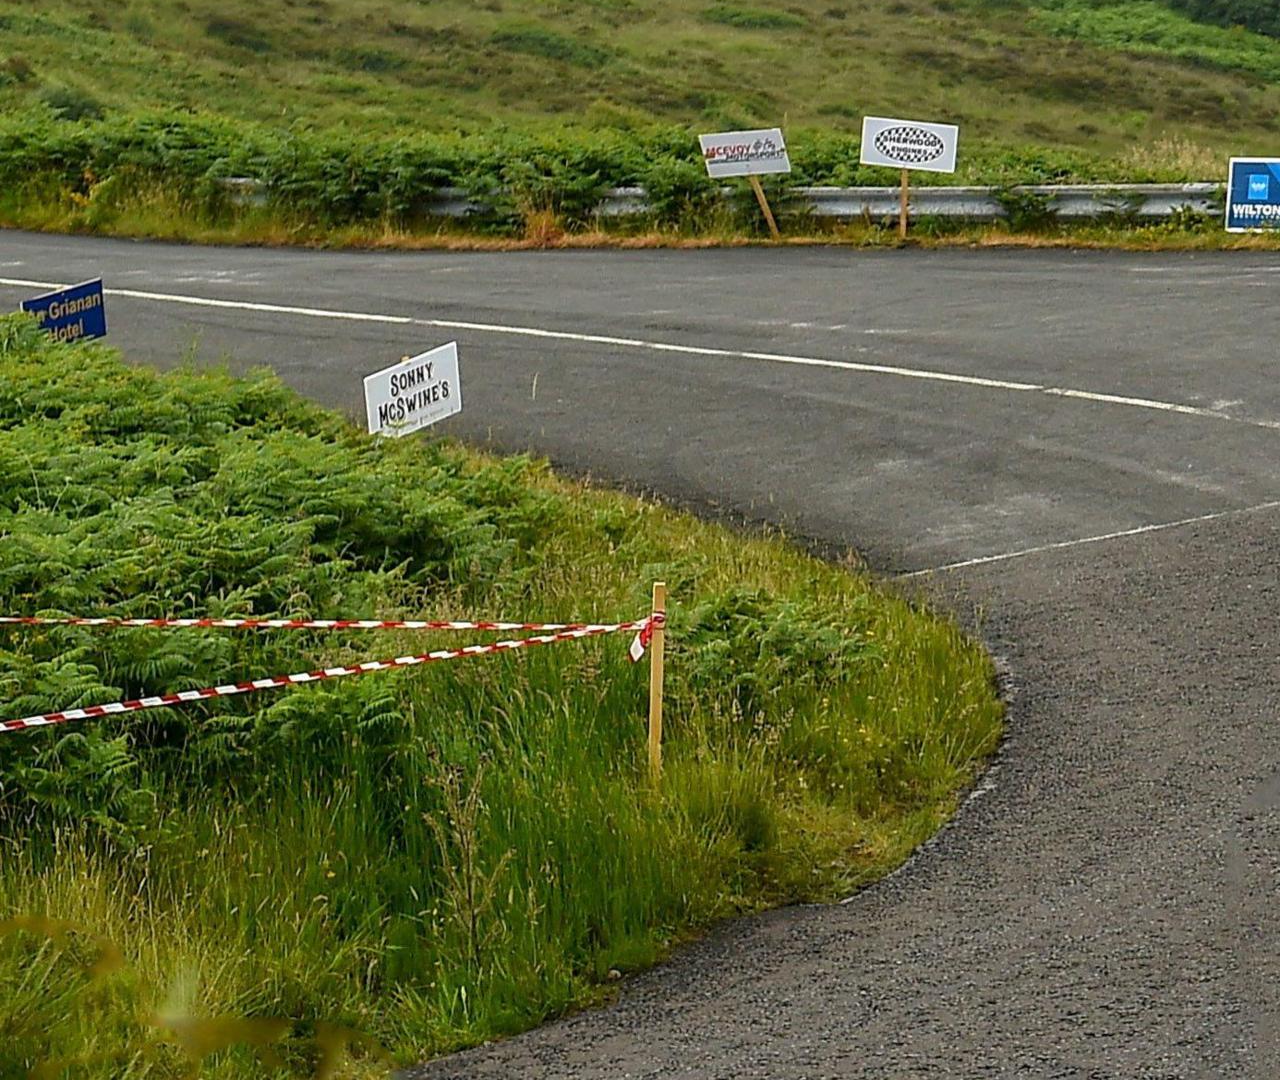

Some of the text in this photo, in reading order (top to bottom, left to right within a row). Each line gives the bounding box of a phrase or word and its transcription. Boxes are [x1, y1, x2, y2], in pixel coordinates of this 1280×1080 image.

[883, 135, 937, 147] SHERWOOD
[891, 146, 927, 155] ENGINES
[48, 293, 101, 320] Grianan
[47, 318, 84, 342] Hotel
[390, 361, 433, 397] SONNY
